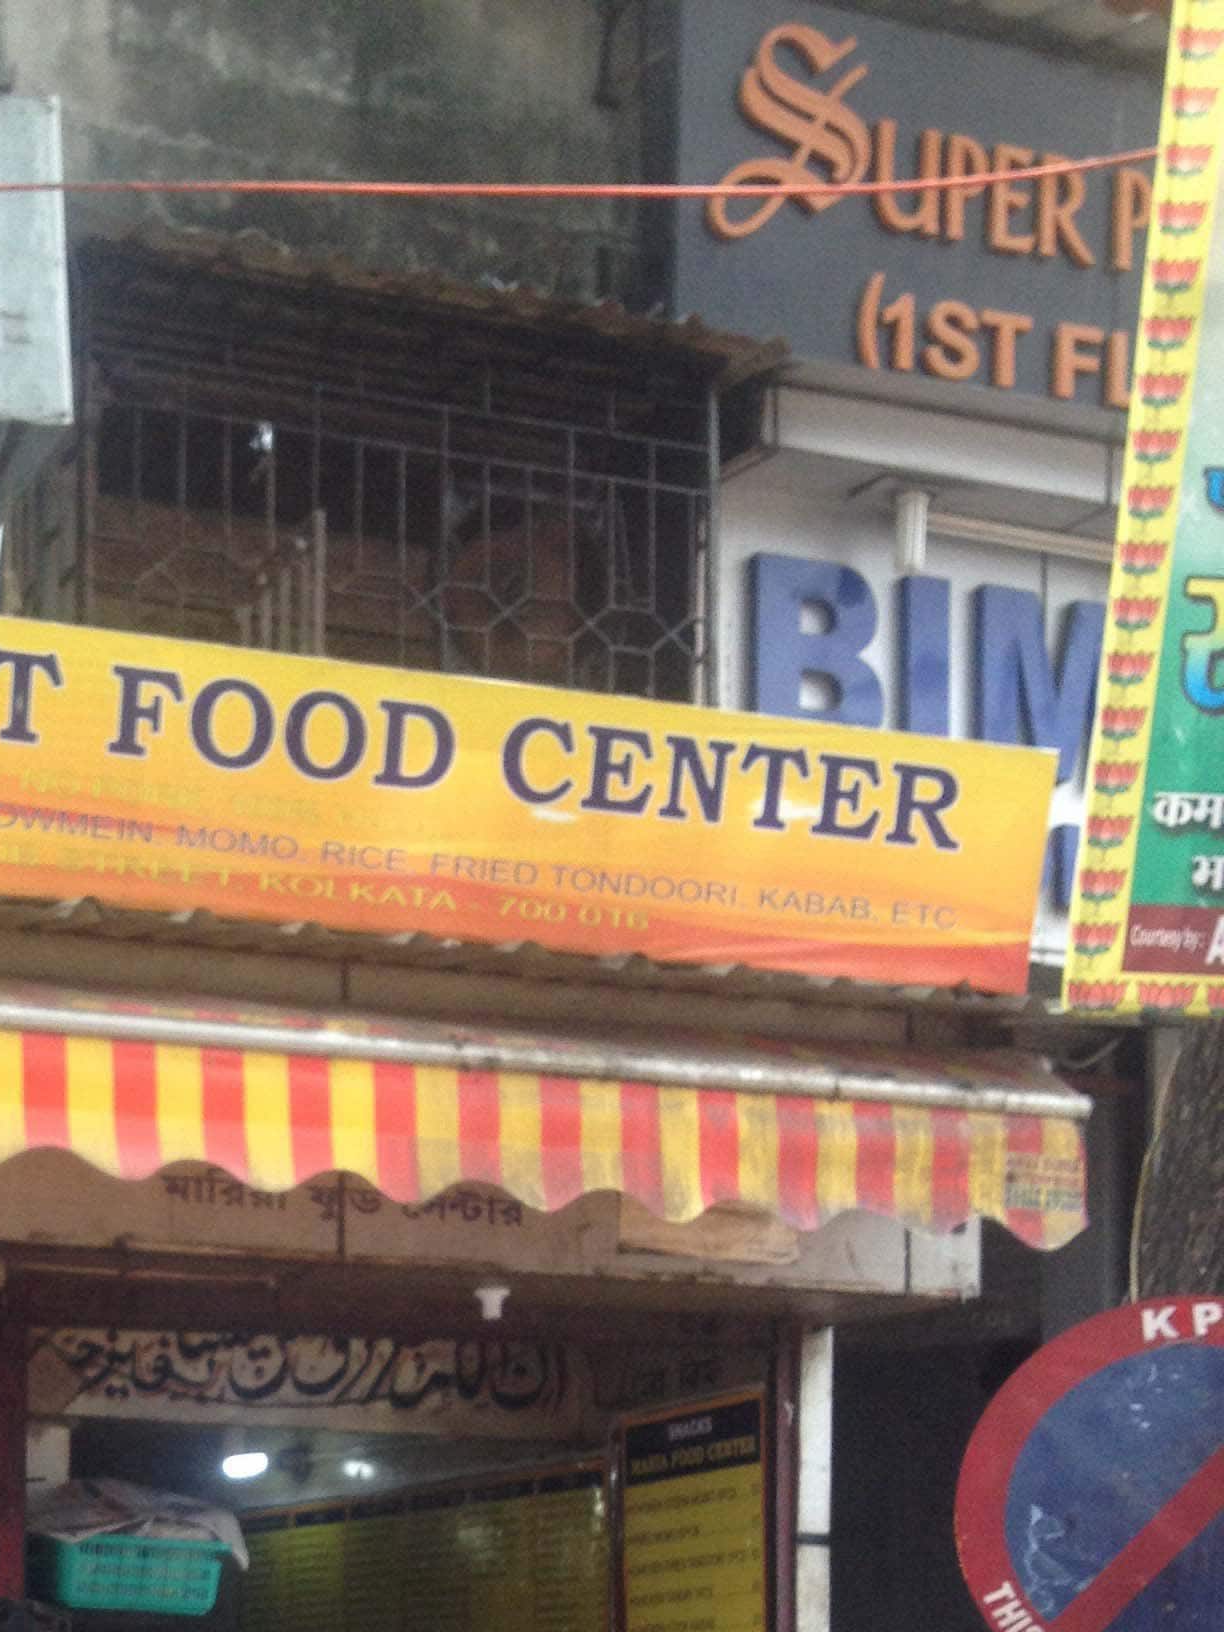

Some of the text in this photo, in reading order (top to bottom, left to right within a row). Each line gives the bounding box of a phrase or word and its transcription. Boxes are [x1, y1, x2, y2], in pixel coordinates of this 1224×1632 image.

[704, 22, 1096, 268] SUPER
[857, 272, 1033, 389] (1ST
[107, 664, 455, 791] FOOD
[502, 716, 960, 851] CENTER
[259, 870, 457, 915] KOLKATA
[496, 895, 568, 924] 700
[430, 851, 539, 887] FRIED
[891, 897, 958, 931] ETC
